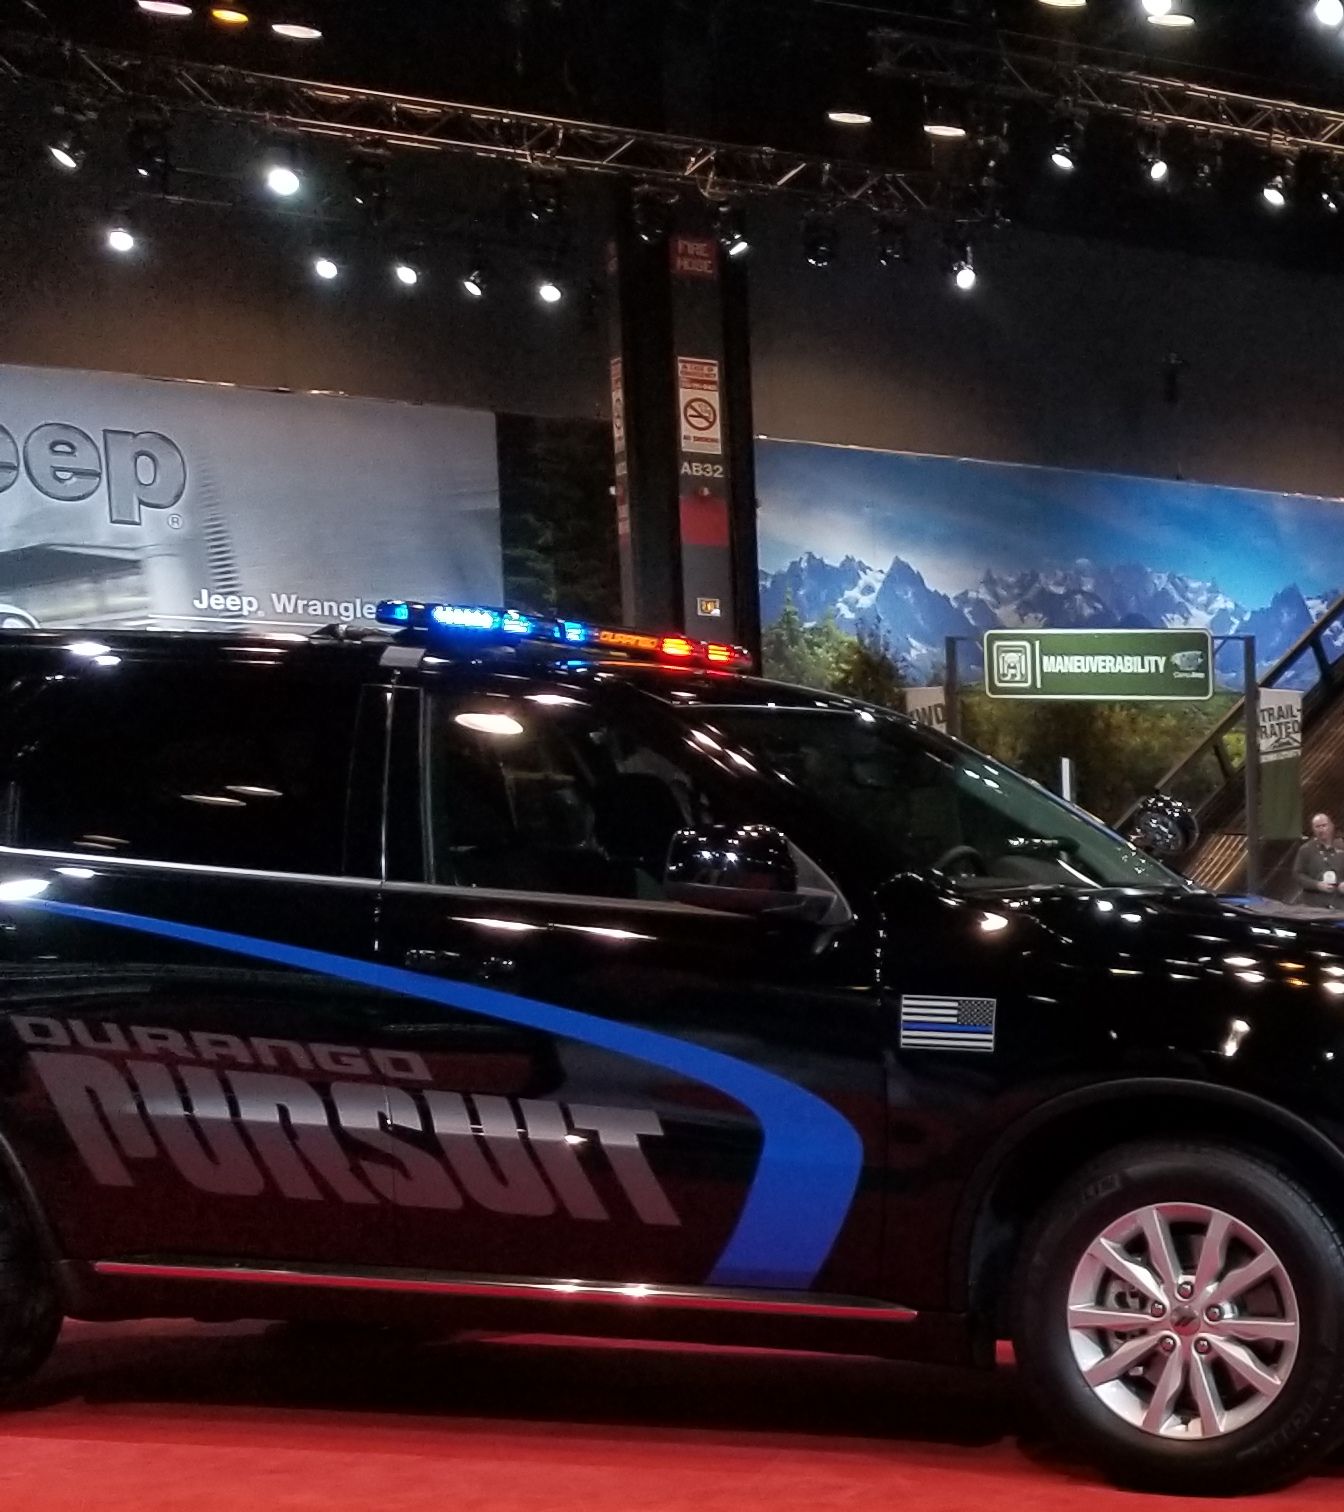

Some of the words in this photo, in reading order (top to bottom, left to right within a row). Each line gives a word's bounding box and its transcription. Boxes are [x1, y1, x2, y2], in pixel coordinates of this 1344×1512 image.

[0, 422, 187, 526] ep
[680, 461, 724, 478] AB32
[193, 588, 259, 616] Jeep
[270, 593, 377, 622] Wrangle
[1042, 655, 1167, 674] MANEUVERABILITY
[9, 1014, 433, 1081] DURANGO
[28, 1050, 682, 1227] PURSUIT
